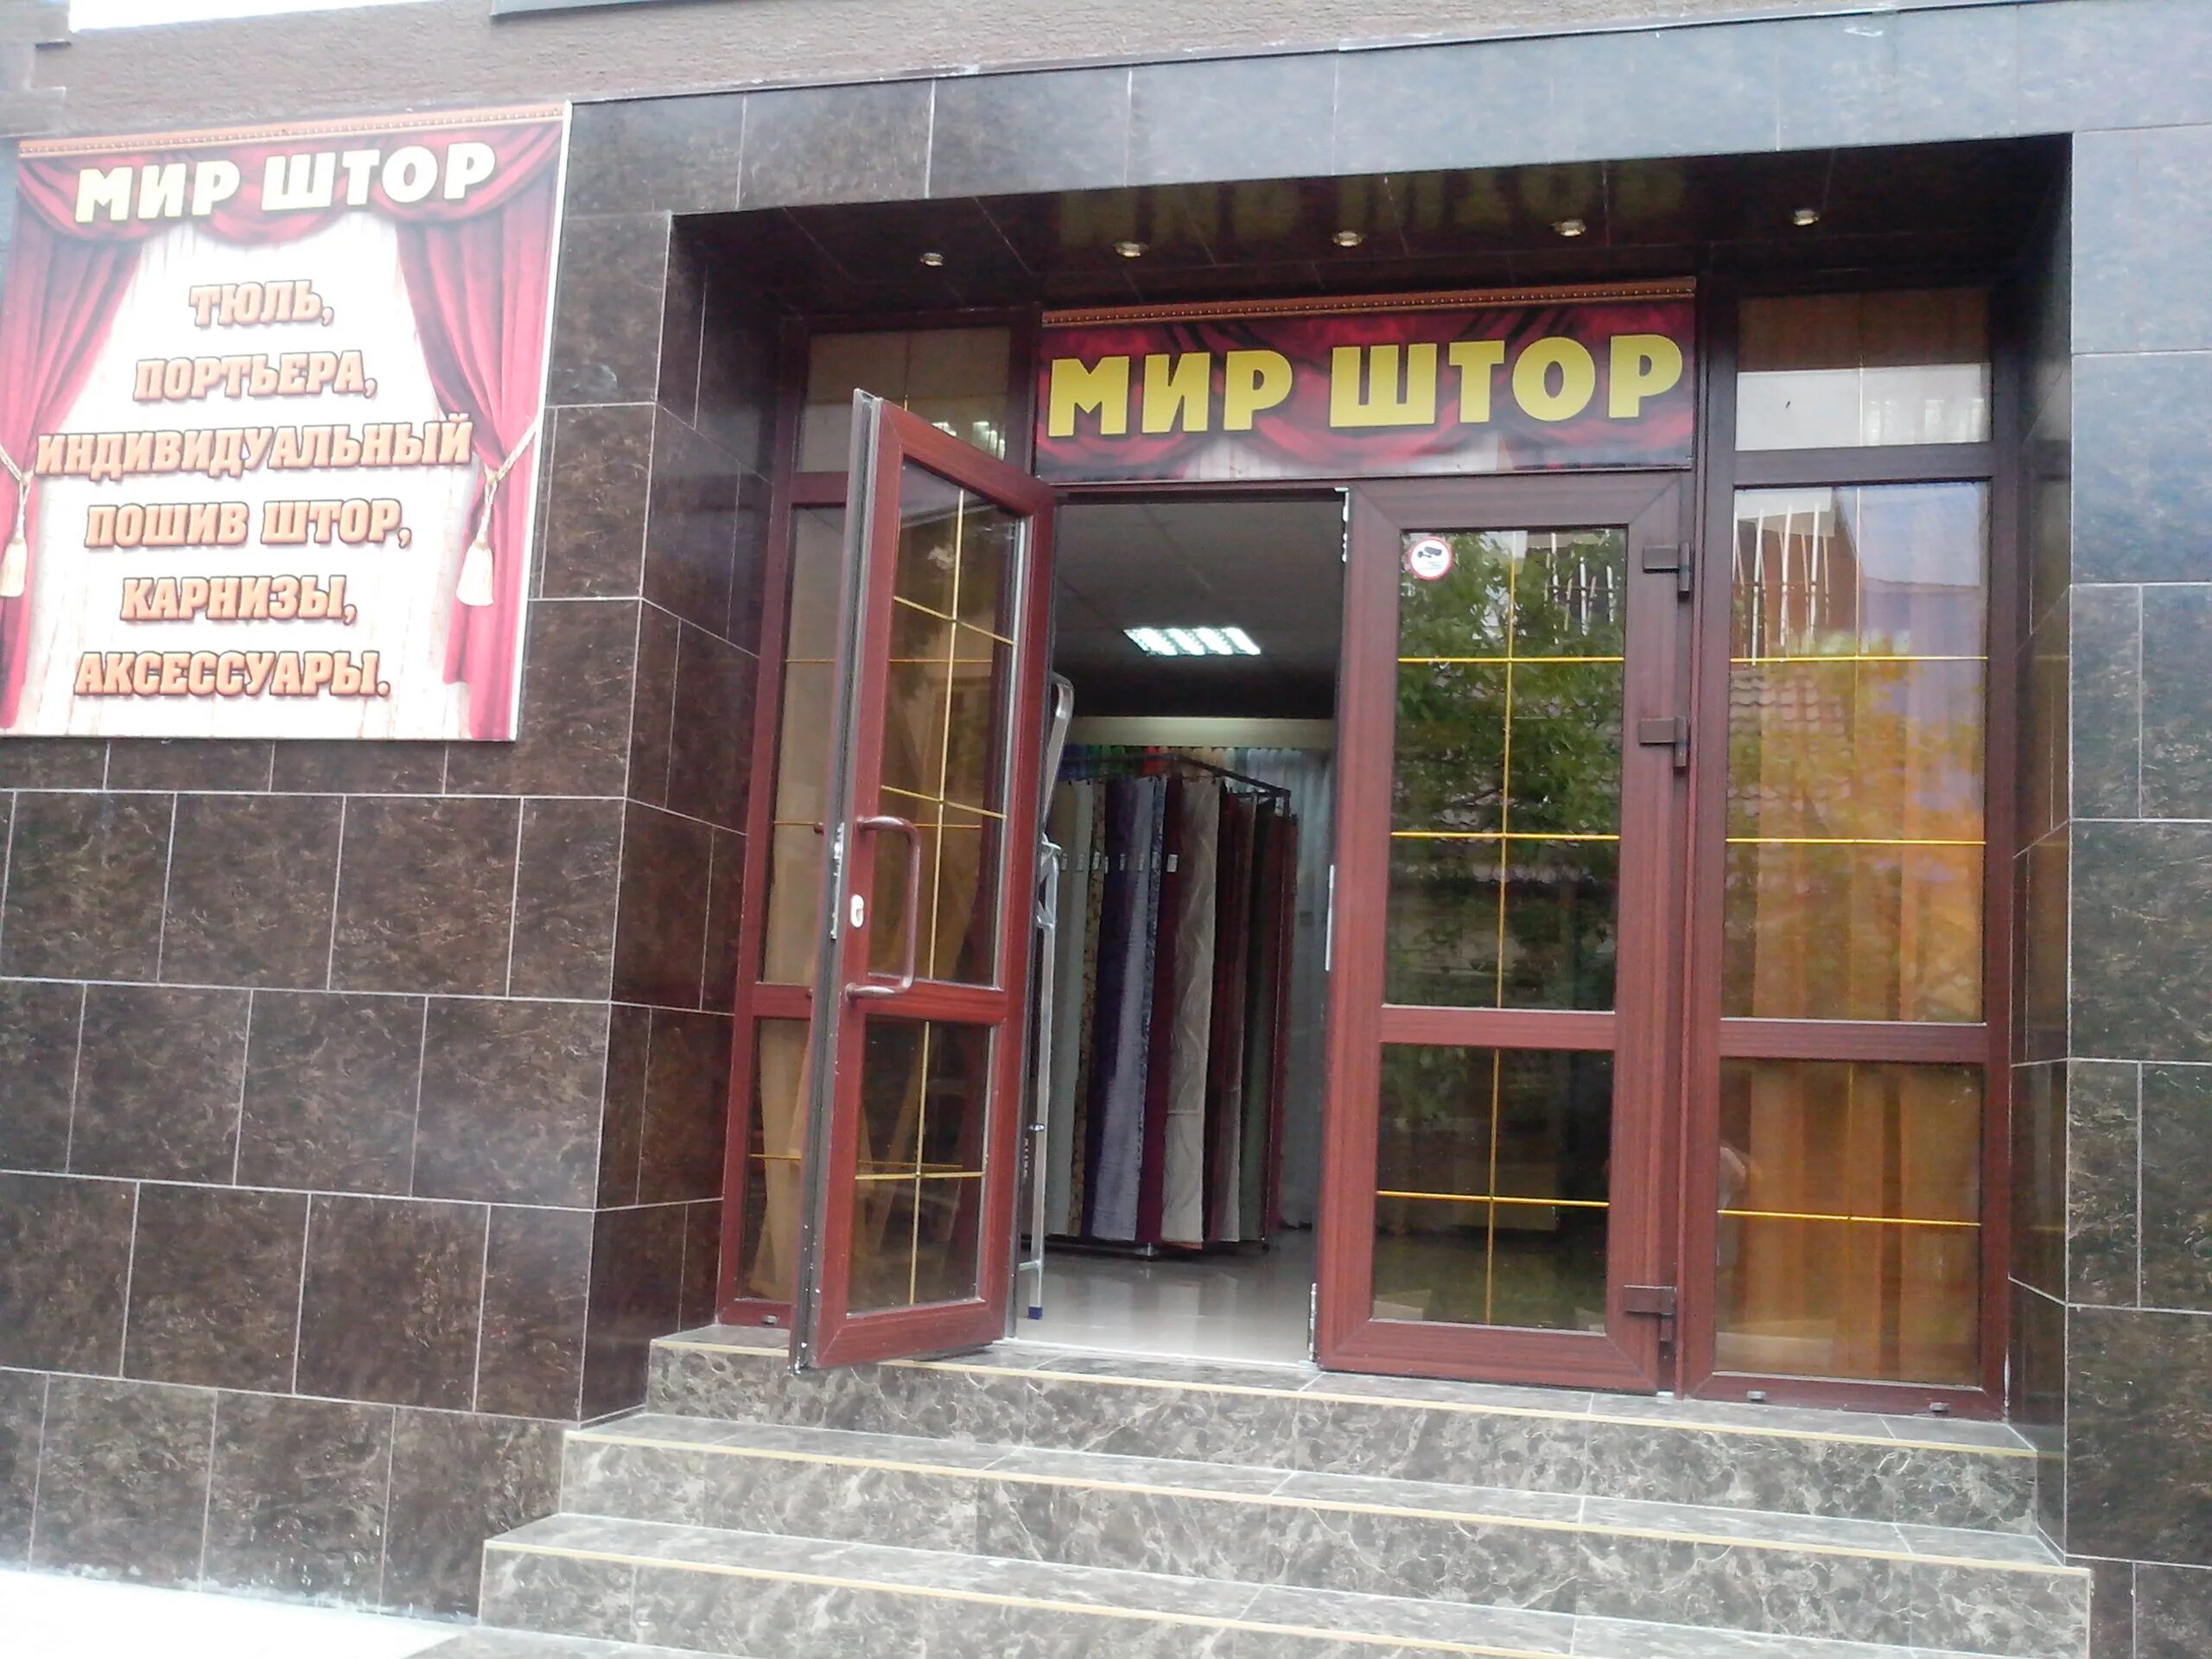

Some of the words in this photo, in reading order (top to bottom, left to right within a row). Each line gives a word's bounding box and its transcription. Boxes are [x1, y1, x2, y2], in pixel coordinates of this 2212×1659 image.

[74, 160, 241, 223] МИР
[261, 142, 497, 212] ШТОР
[189, 279, 335, 327] ТЮЛЬ,
[132, 350, 378, 402] ПОРТЬЕРА,
[1047, 349, 1294, 437] МИР
[1329, 334, 1683, 428] ШТОР
[35, 413, 474, 482] ИНДИВИДУАЛЬНЫЙ
[85, 502, 250, 548] ПОШИВ
[260, 498, 412, 549] ШТОР,
[120, 575, 357, 625] КАРНИЗЫ,
[73, 650, 391, 697] АКСЕССУАРЫ.
